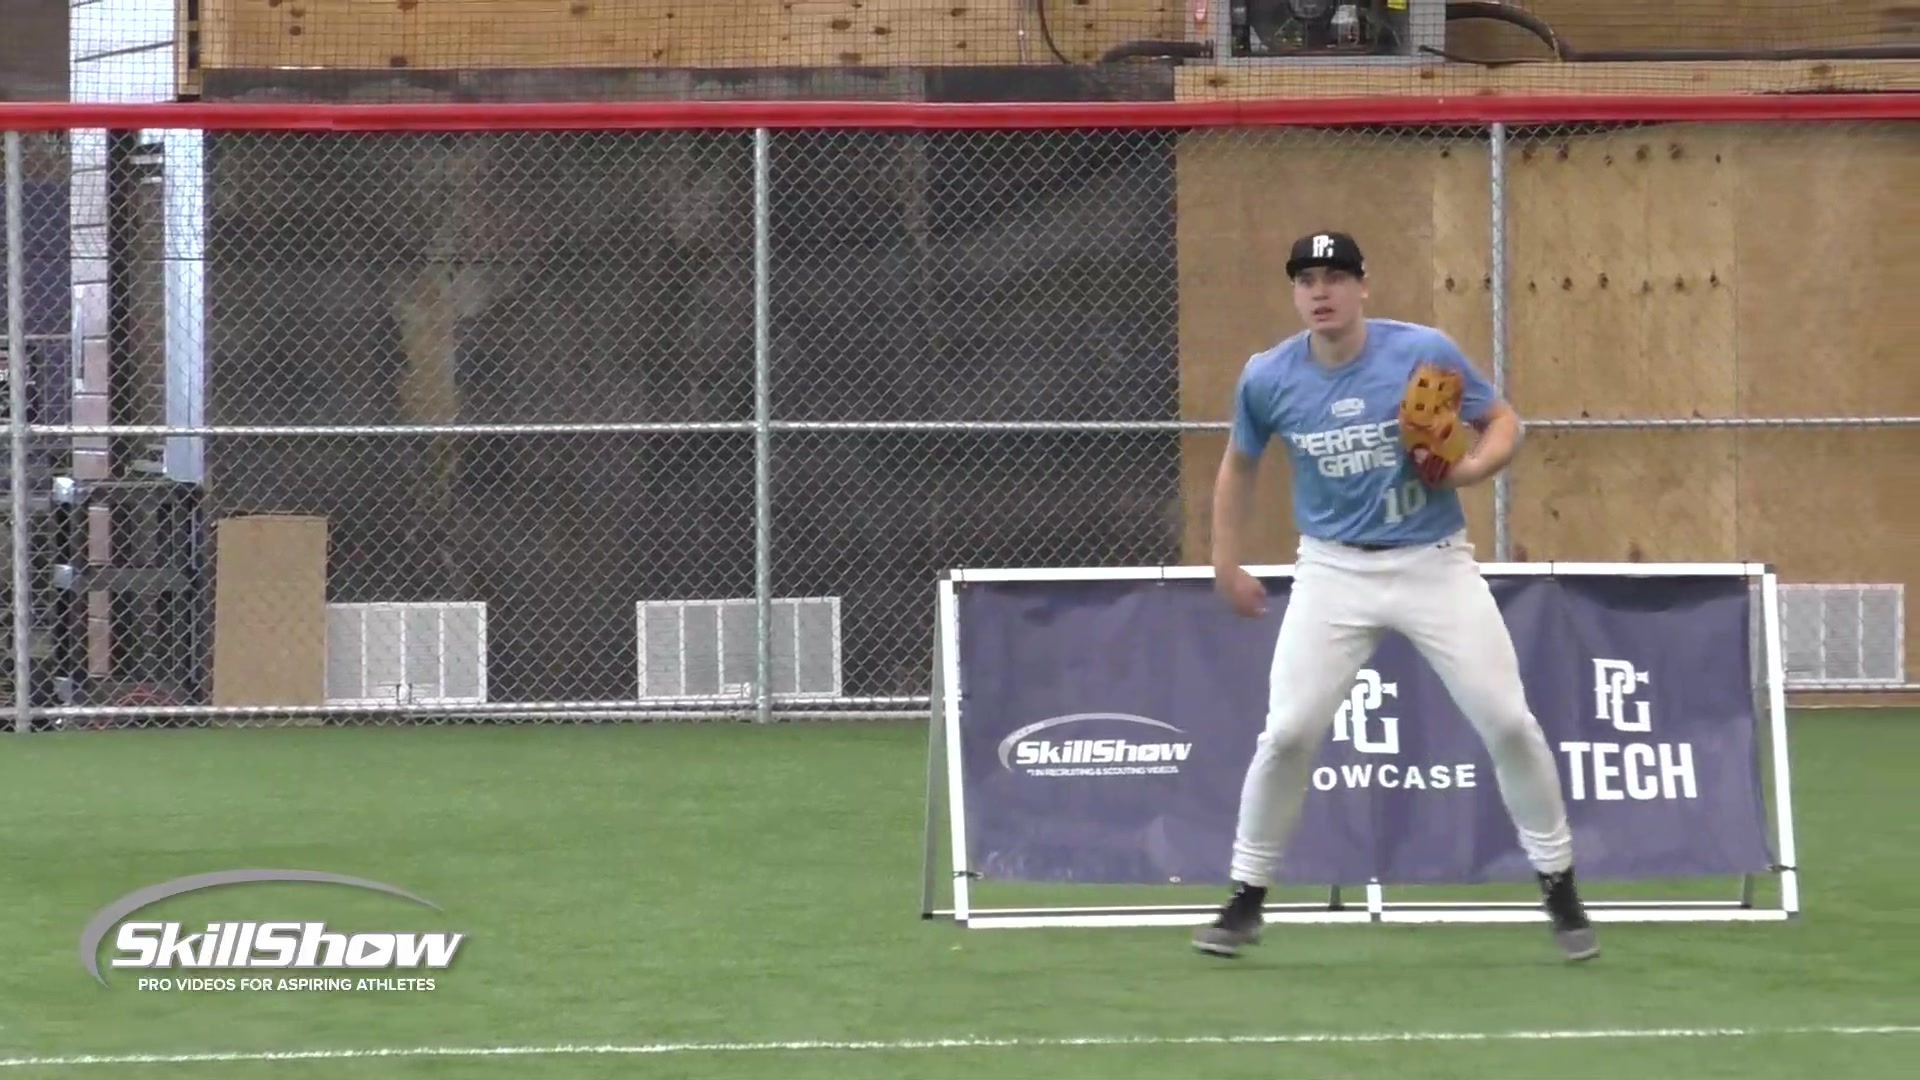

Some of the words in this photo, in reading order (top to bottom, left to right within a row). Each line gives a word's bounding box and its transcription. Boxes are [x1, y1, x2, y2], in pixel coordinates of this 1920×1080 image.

[1290, 418, 1400, 458] PERFEC
[1318, 446, 1397, 477] GAME
[1383, 480, 1427, 524] 10
[1016, 739, 1192, 765] SkillShow
[1312, 763, 1477, 791] OWCASE
[1560, 740, 1698, 801] TECH
